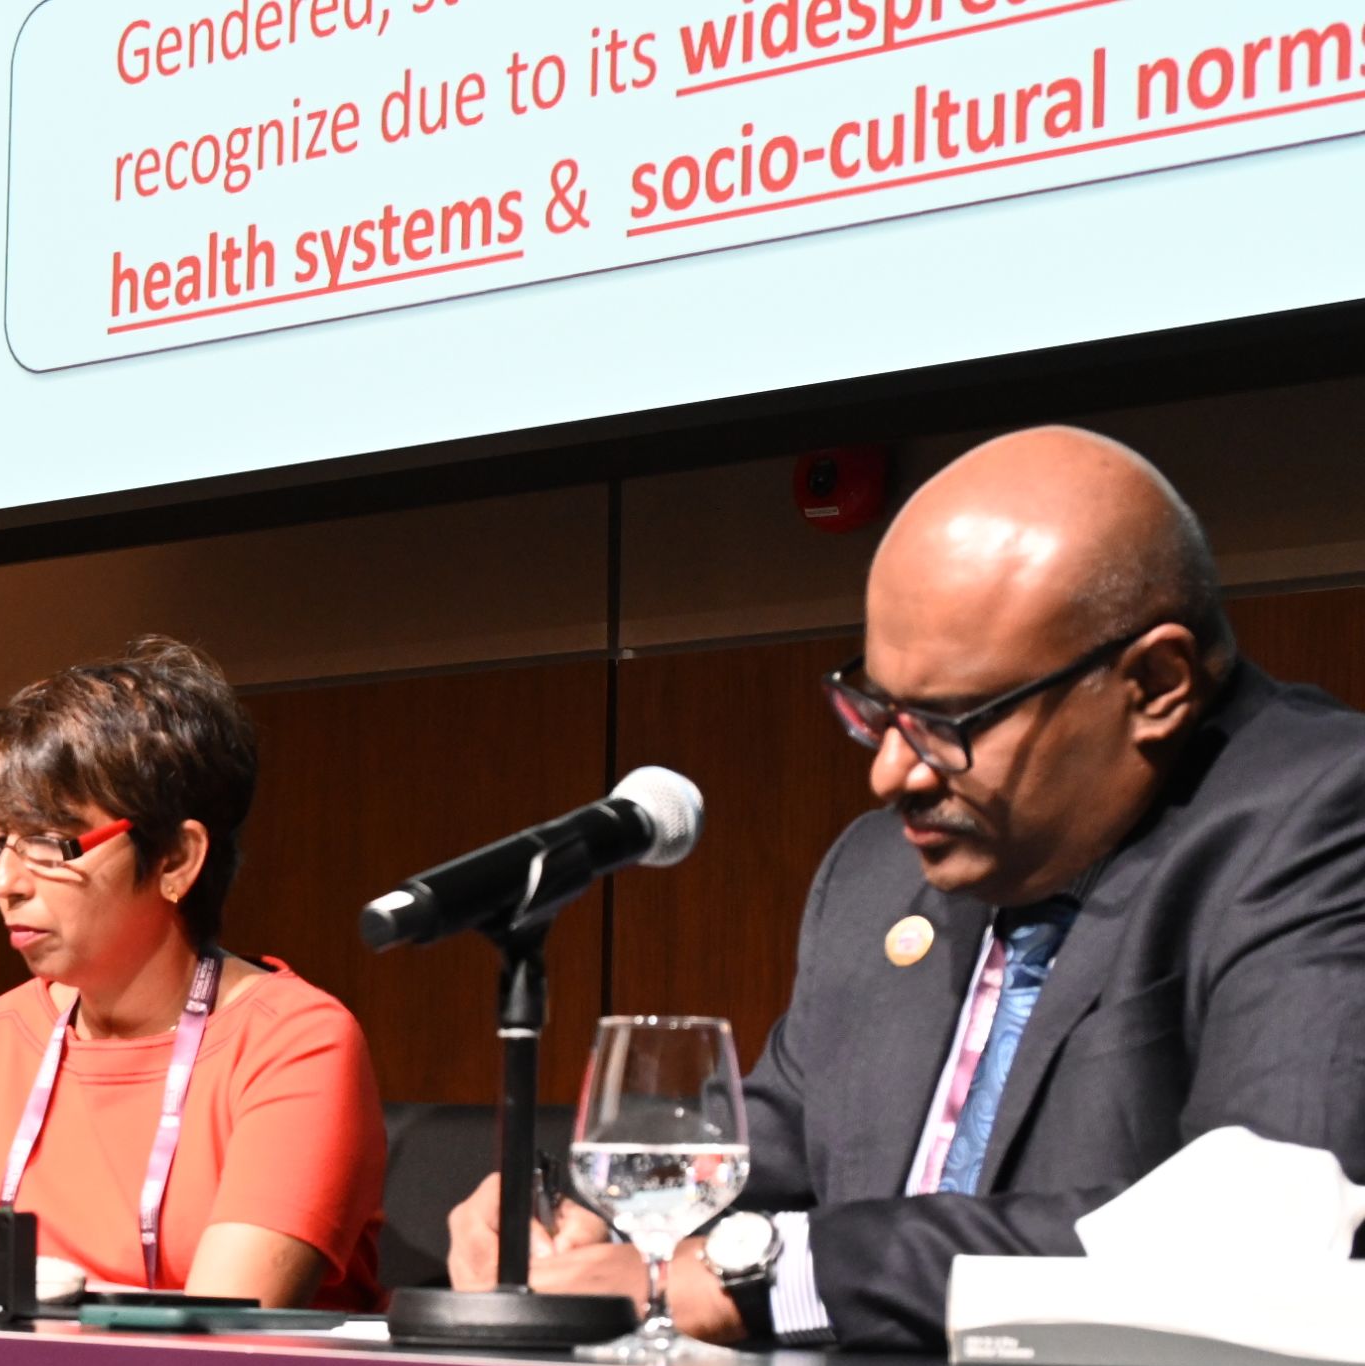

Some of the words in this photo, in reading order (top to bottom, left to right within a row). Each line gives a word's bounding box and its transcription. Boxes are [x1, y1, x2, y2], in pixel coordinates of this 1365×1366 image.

[111, 224, 275, 317] health
[295, 189, 524, 288] systems
[545, 158, 590, 234] &
[630, 47, 1107, 219] socio-cultural
[1137, 22, 1365, 120] norm
[113, 98, 360, 200] recognize
[381, 69, 487, 143] due
[507, 50, 566, 115] to
[590, 27, 657, 97] its
